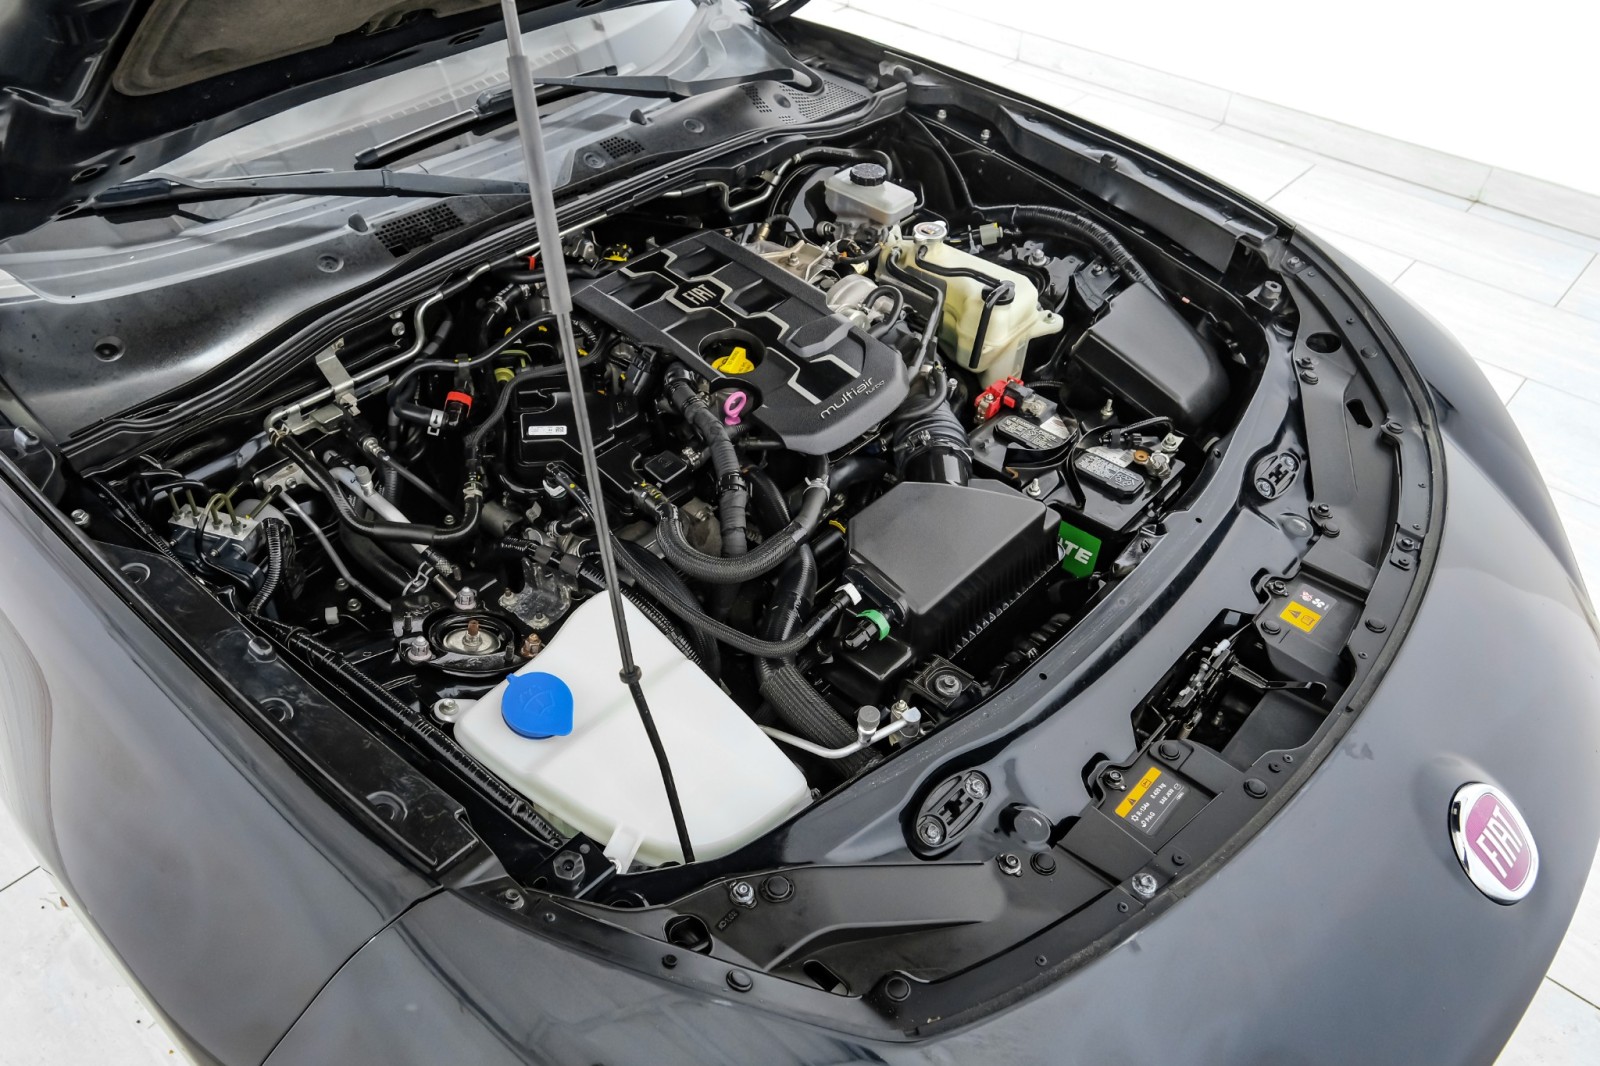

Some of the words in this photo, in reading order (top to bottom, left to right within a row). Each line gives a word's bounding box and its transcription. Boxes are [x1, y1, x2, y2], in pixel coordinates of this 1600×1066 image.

[682, 284, 717, 305] FIAT
[820, 377, 873, 420] multiair
[865, 380, 886, 396] turbo
[1058, 537, 1092, 565] TE
[1145, 811, 1155, 822] PAG
[1476, 804, 1523, 879] FIAT
